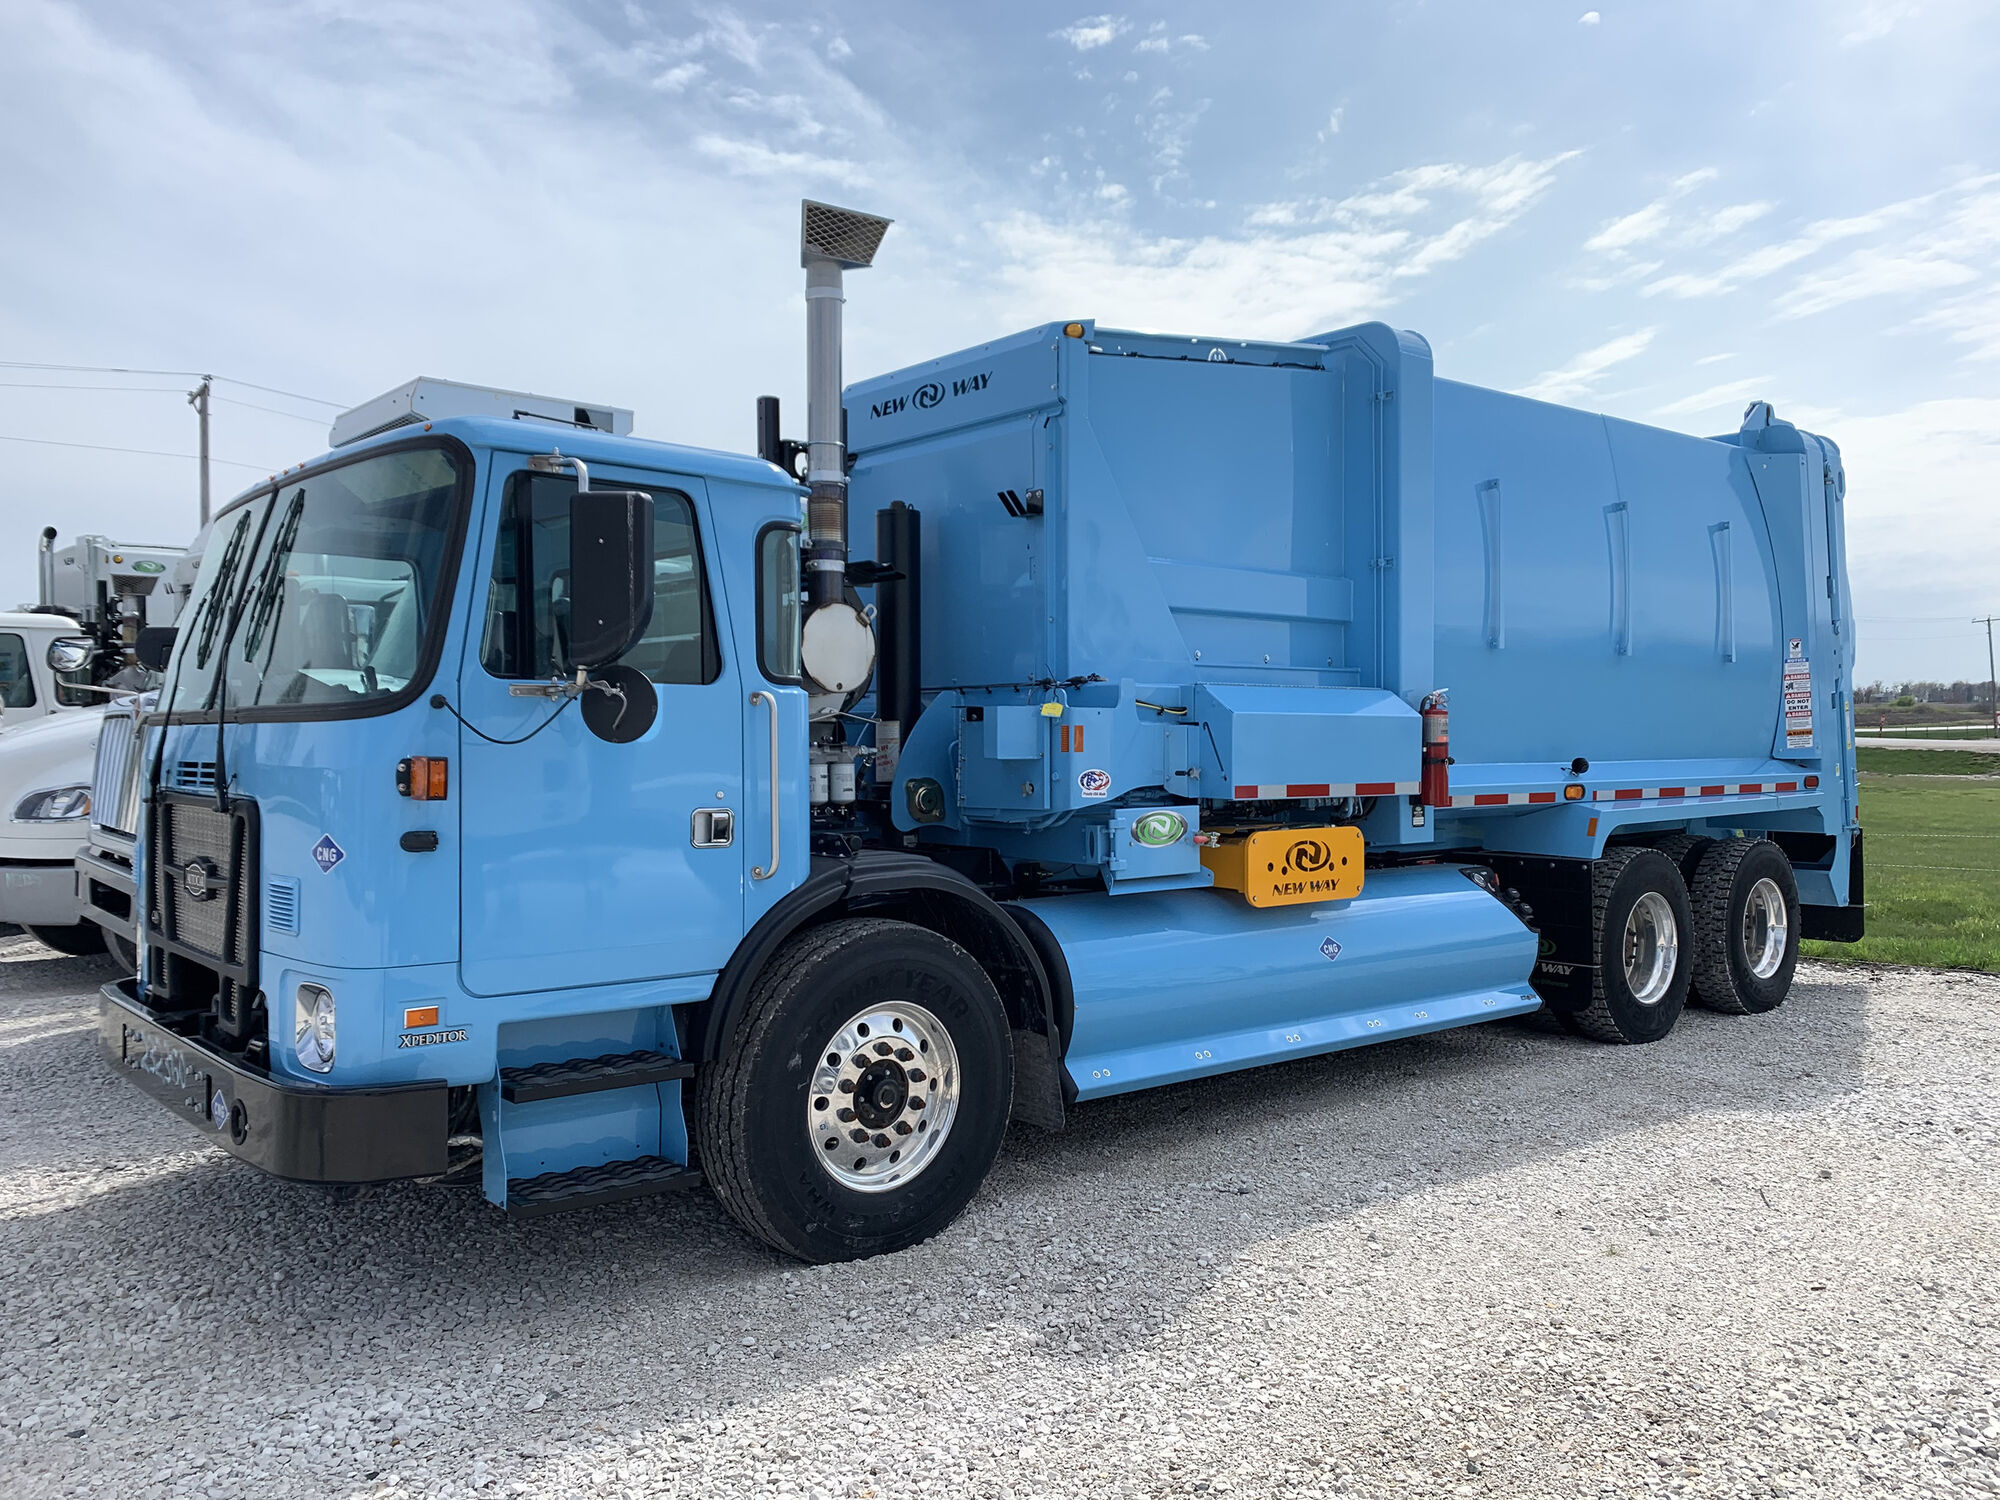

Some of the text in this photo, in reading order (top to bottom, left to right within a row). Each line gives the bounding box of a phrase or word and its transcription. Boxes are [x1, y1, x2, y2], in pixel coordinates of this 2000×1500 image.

[870, 395, 909, 420] NEW
[952, 371, 993, 397] WAY
[316, 847, 337, 863] CNG
[1272, 878, 1341, 897] NEW WAY
[1323, 943, 1339, 954] CNG
[1541, 963, 1574, 975] WAY
